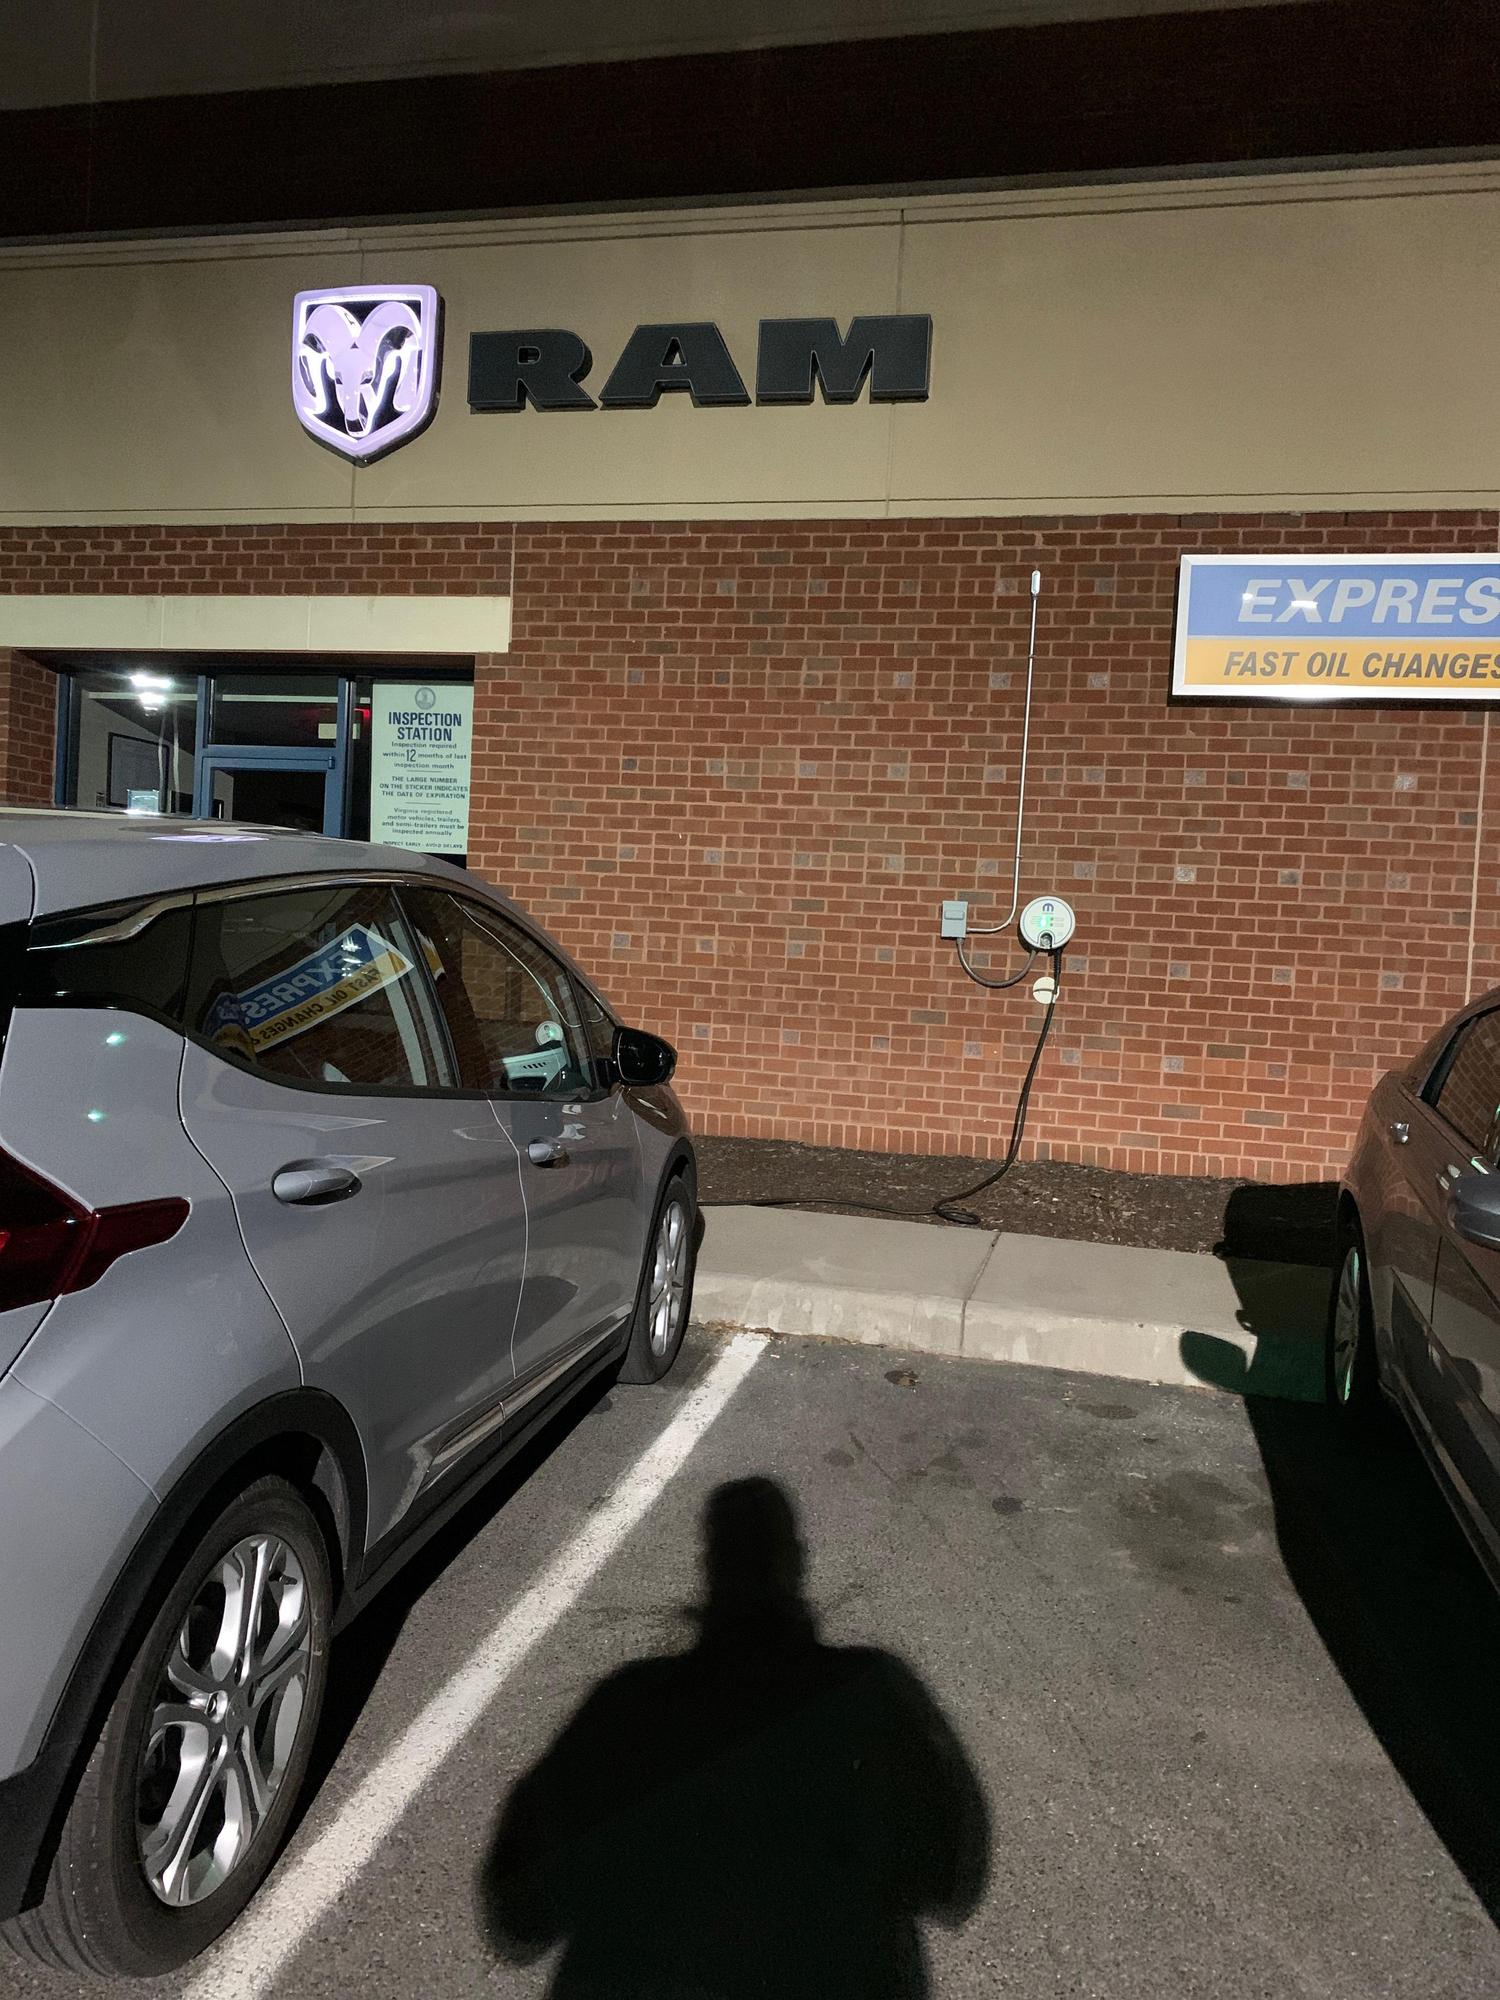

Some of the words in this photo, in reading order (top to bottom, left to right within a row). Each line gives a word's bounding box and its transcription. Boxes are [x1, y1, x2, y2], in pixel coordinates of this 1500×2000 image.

[468, 314, 933, 414] RAM
[1238, 577, 1500, 625] EXPRES
[1224, 651, 1299, 677] FAST
[1306, 652, 1350, 678] OIL
[388, 712, 462, 726] INSPECTION
[397, 727, 452, 741] STATION
[406, 749, 417, 762] 12
